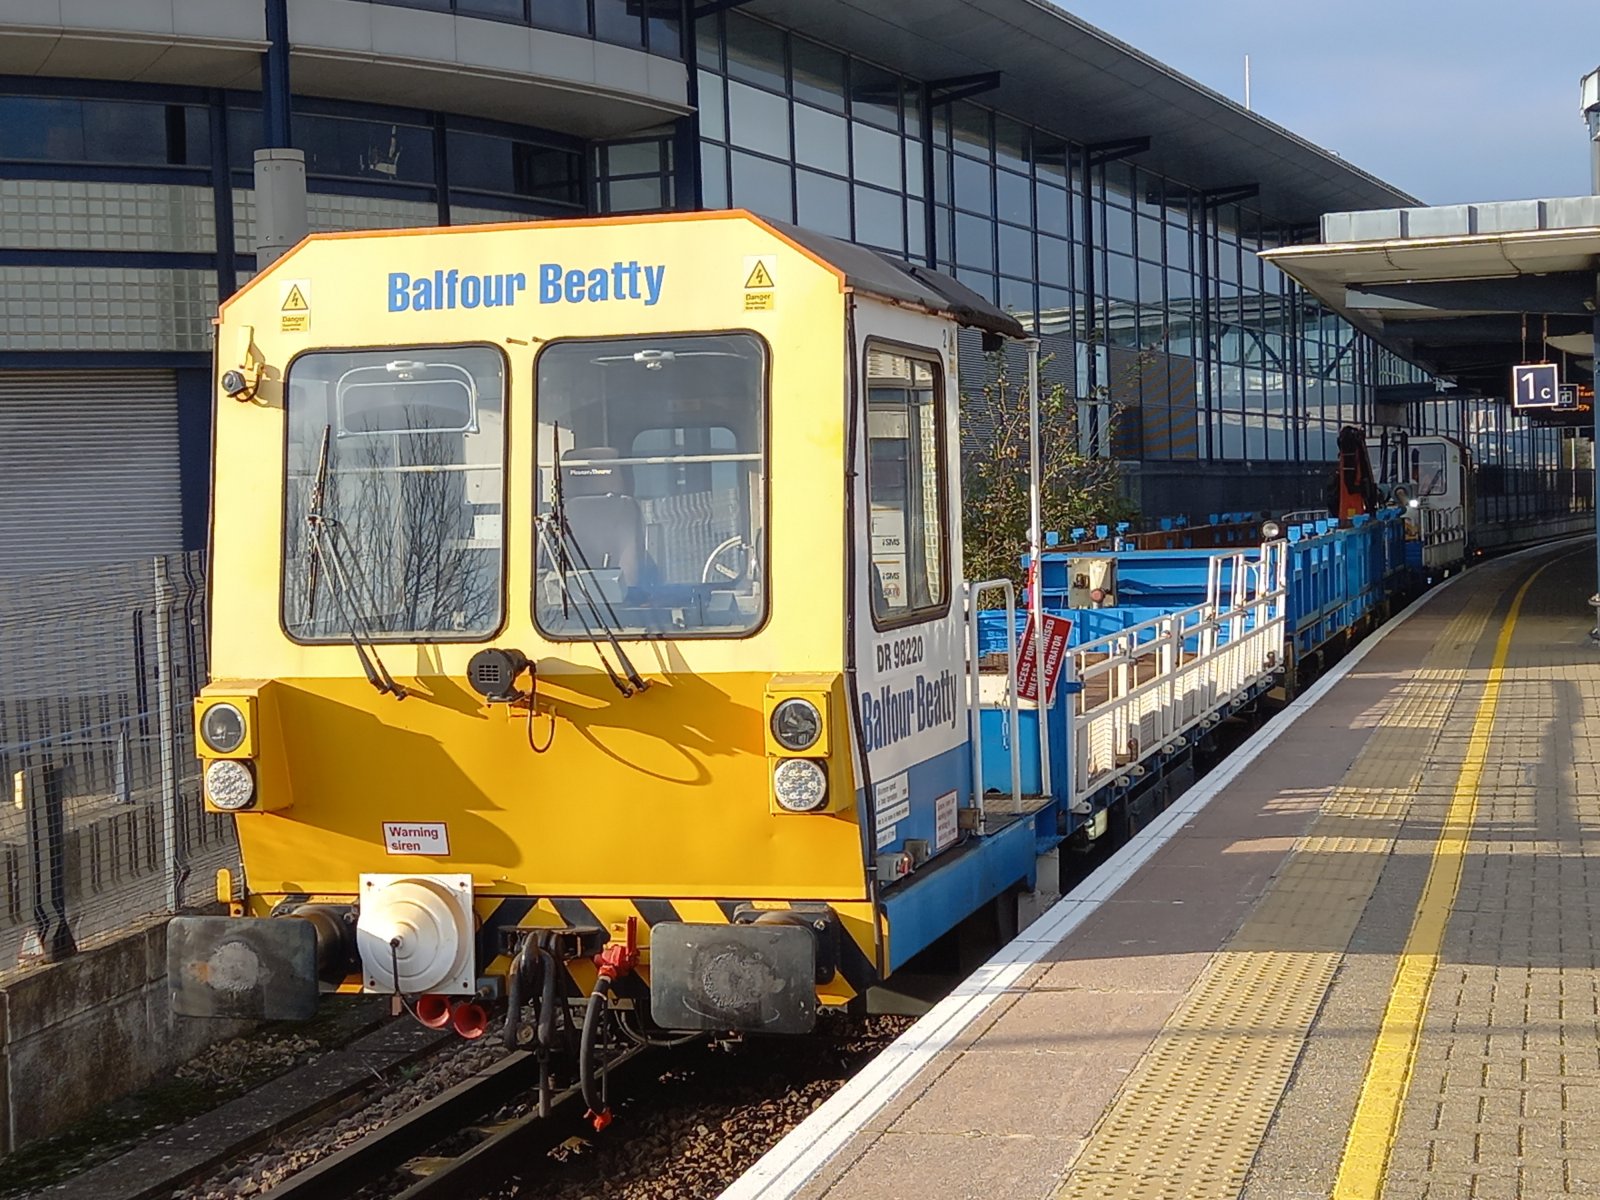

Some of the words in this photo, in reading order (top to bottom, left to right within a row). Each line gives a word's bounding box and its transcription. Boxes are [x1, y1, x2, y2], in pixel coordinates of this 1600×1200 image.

[388, 269, 526, 312] Balfour
[539, 261, 666, 306] Beatty
[745, 293, 771, 301] Danger
[876, 643, 892, 673] DR
[893, 635, 924, 669] 98220
[1045, 635, 1063, 675] OPERATOR
[1017, 661, 1031, 693] ACCESS
[1026, 667, 1038, 697] UNLE
[861, 684, 915, 754] Balfour
[916, 669, 957, 732] Beatty
[389, 826, 439, 840] Warning
[391, 840, 421, 851] siren
